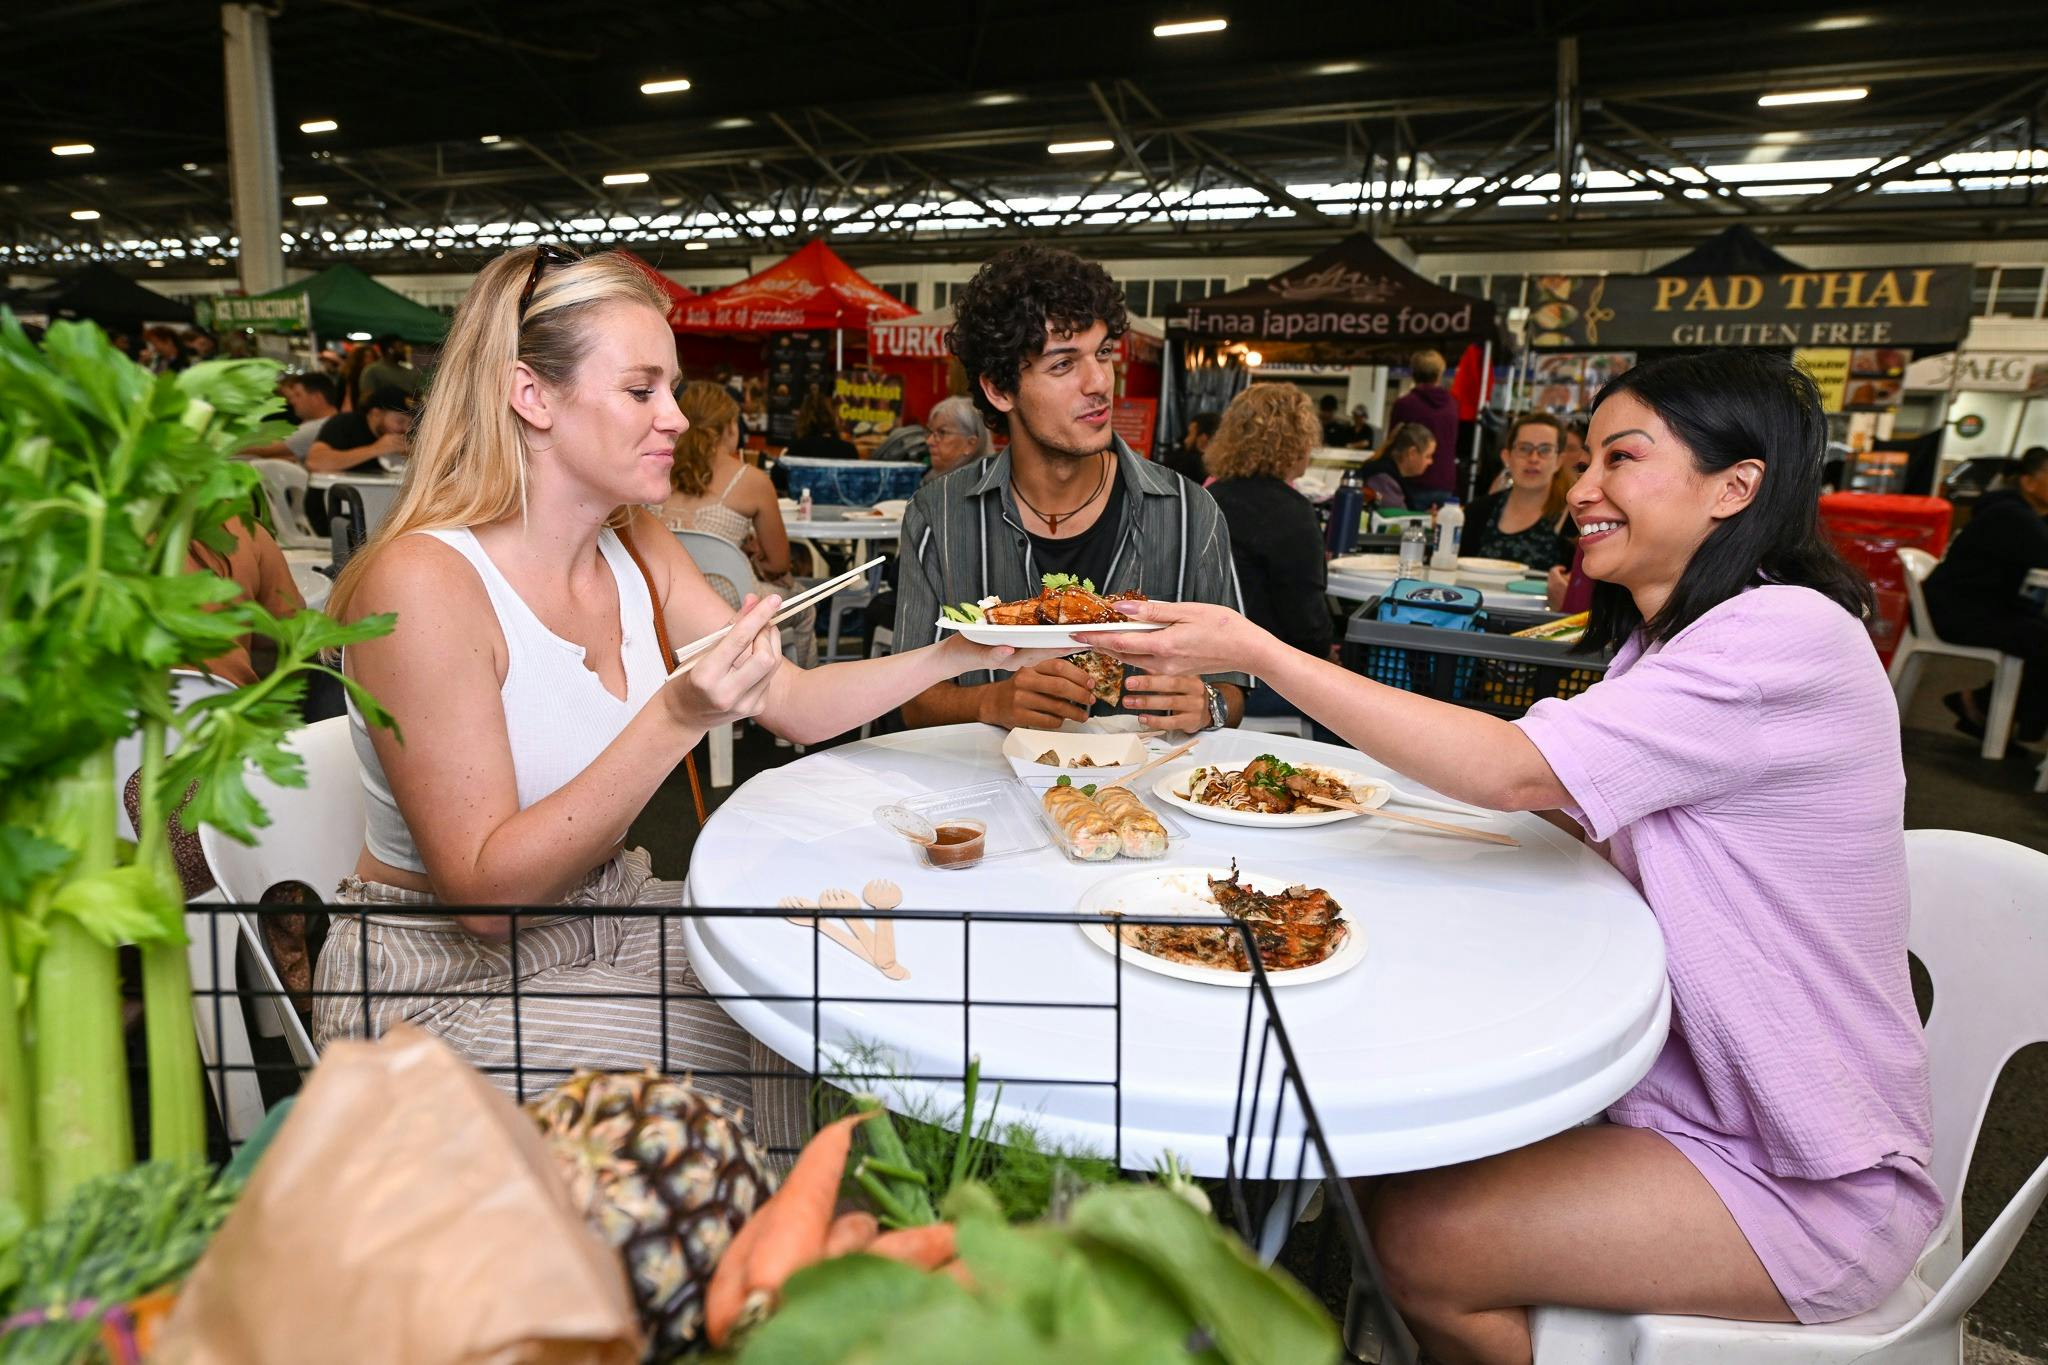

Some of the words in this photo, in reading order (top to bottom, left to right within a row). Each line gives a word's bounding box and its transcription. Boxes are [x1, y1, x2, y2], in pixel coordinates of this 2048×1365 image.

[1653, 274, 1764, 312] PAD
[1779, 268, 1935, 310] THAI
[1262, 308, 1389, 339] japanese
[1397, 304, 1471, 334] food
[1671, 322, 1801, 346] GLUTEN
[1810, 321, 1892, 344] FREE
